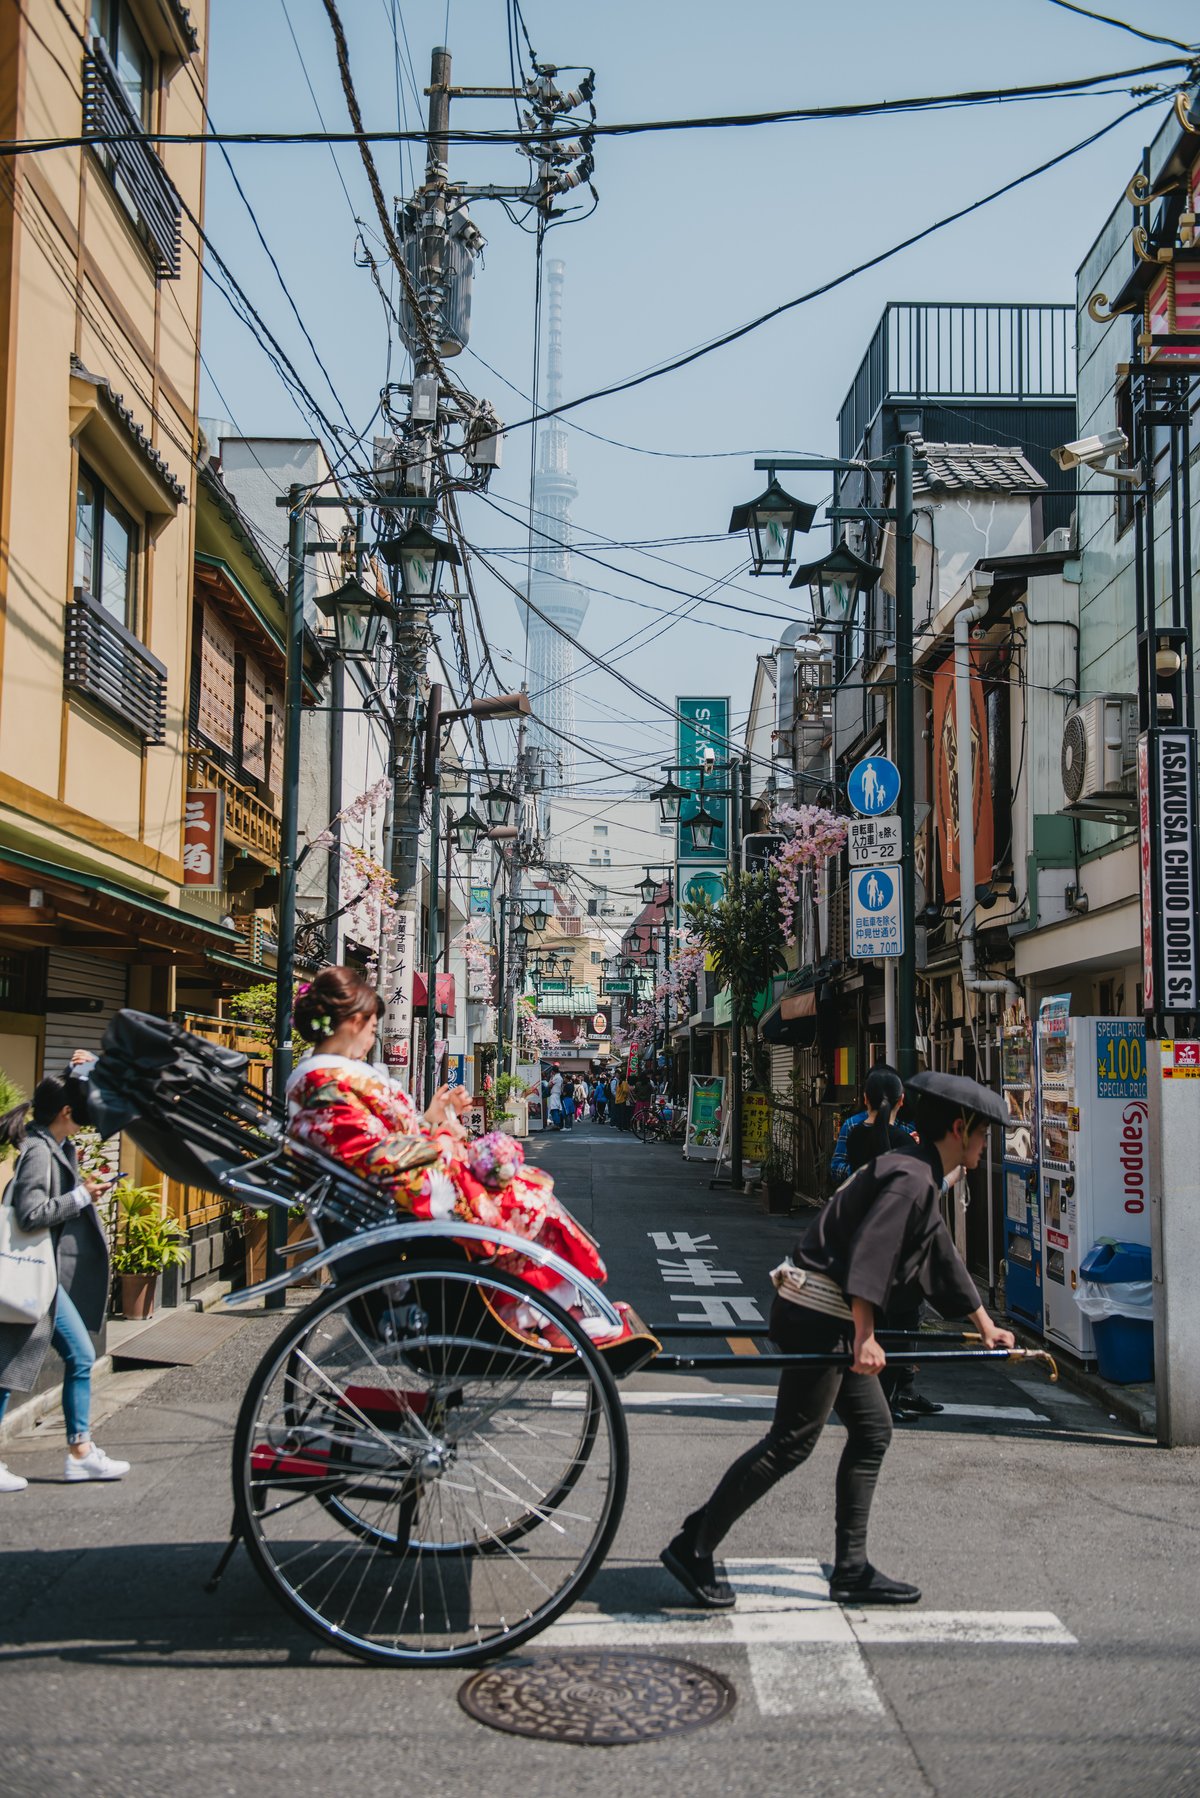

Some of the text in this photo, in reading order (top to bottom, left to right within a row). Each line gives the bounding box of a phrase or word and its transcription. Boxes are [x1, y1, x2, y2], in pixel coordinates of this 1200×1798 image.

[852, 823, 874, 836] 自転車
[878, 826, 897, 839] を除く
[852, 834, 875, 847] 人力車
[1162, 741, 1192, 1007] ASAKUSA CHUO DORI St.
[856, 915, 896, 928] 自転車を除く
[856, 926, 897, 939] 仲見世通り
[856, 941, 898, 955] この先 70m
[1098, 1022, 1146, 1038] SPECIAL PRIC
[1099, 1082, 1147, 1097] SPECIAL PRIC
